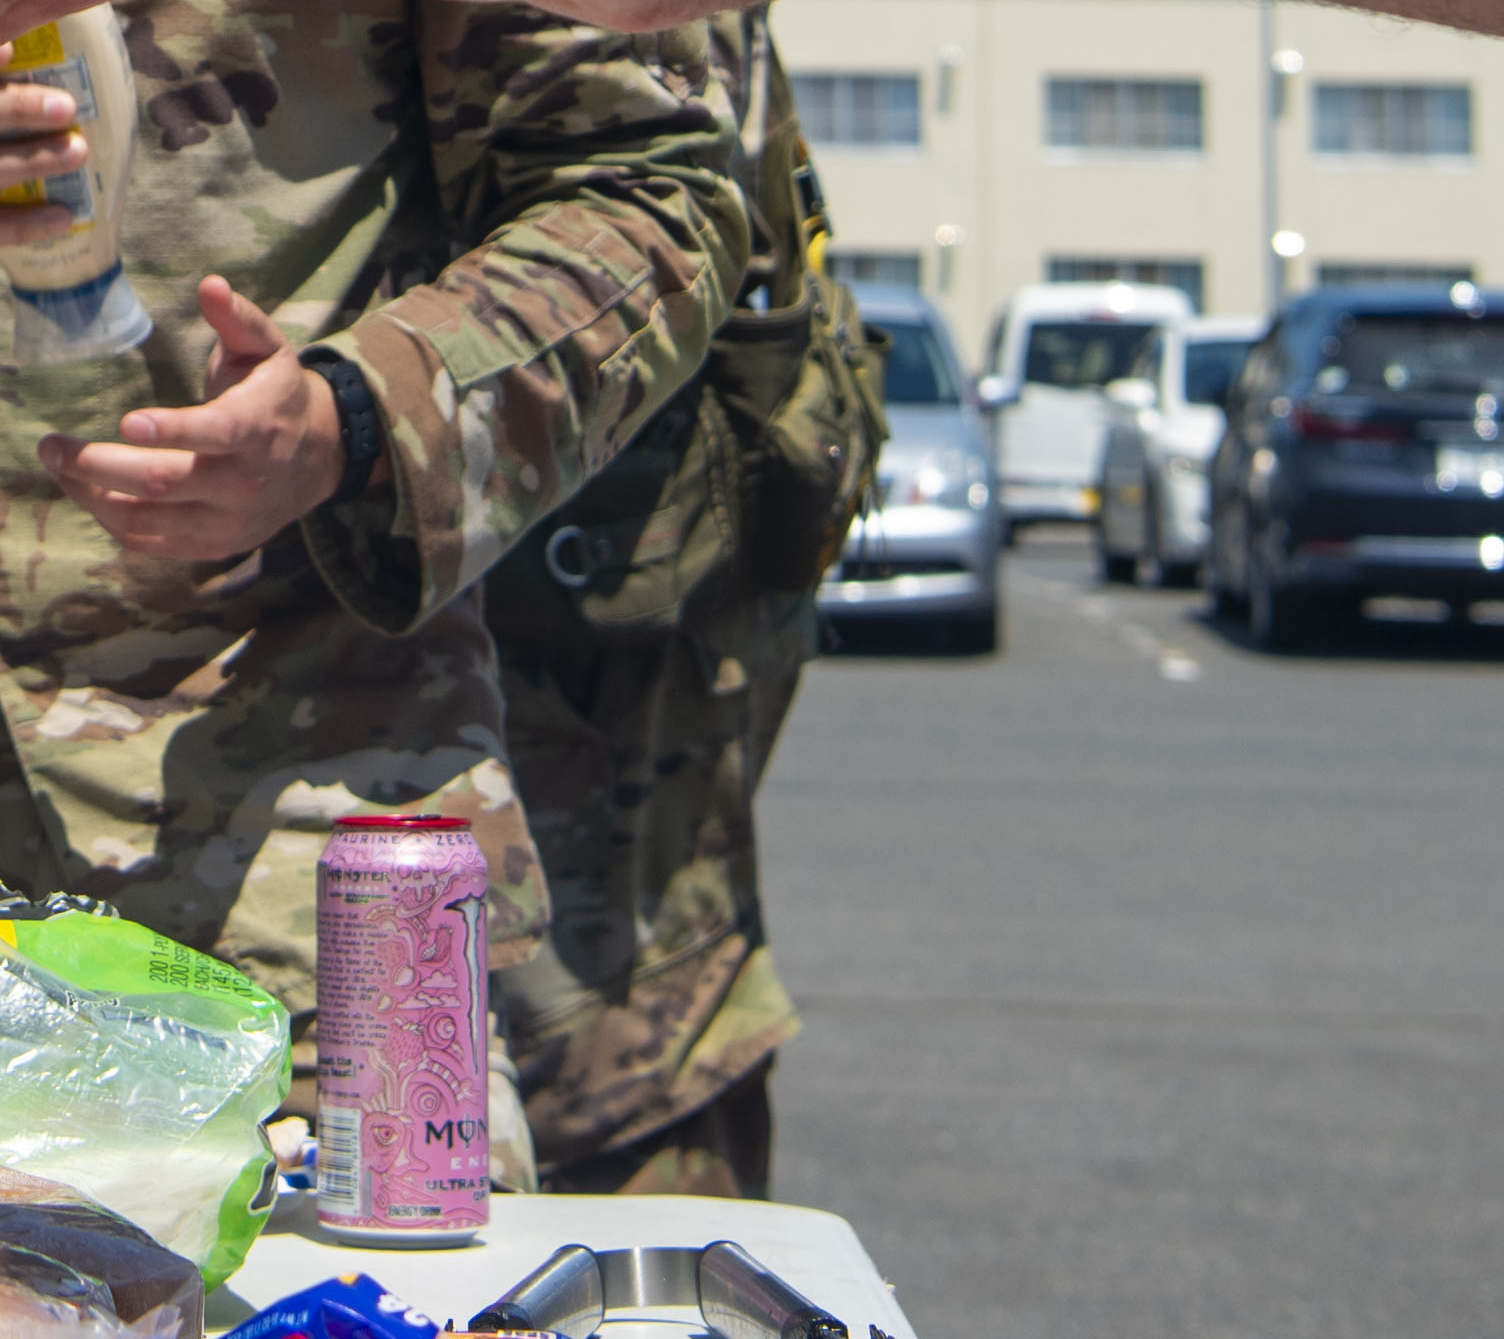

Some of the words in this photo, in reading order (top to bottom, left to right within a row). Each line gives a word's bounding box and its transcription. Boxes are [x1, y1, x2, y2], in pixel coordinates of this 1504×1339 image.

[338, 831, 400, 845] AURINE
[149, 960, 169, 984] 200
[170, 963, 190, 987] 200
[425, 1178, 475, 1191] ULTRA
